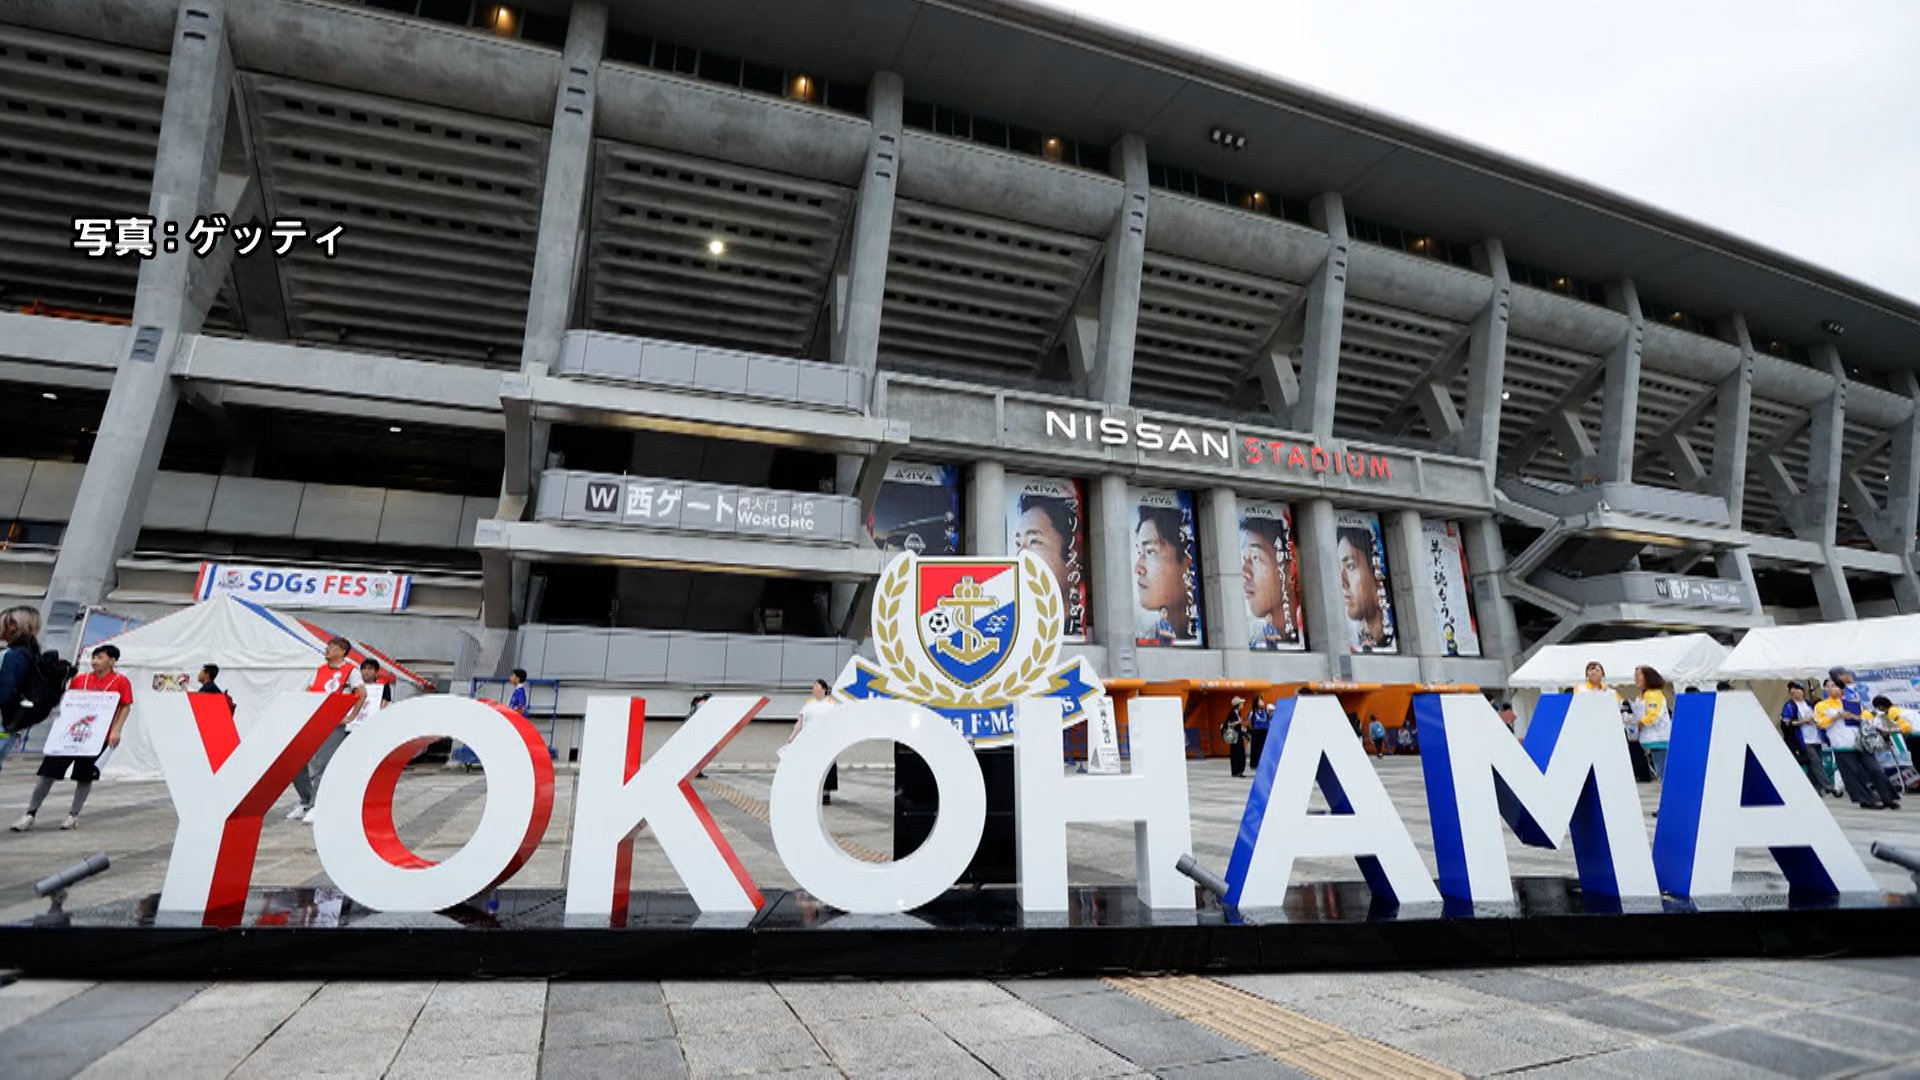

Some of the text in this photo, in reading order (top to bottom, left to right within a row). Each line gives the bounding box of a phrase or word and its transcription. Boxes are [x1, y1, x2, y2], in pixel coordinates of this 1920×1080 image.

[1045, 410, 1394, 481] NISSAN STADIUM
[589, 485, 617, 509] W
[626, 485, 735, 523] 西ゲート
[247, 570, 369, 597] SDGs FES
[155, 691, 1878, 926] YOKOHAMA
